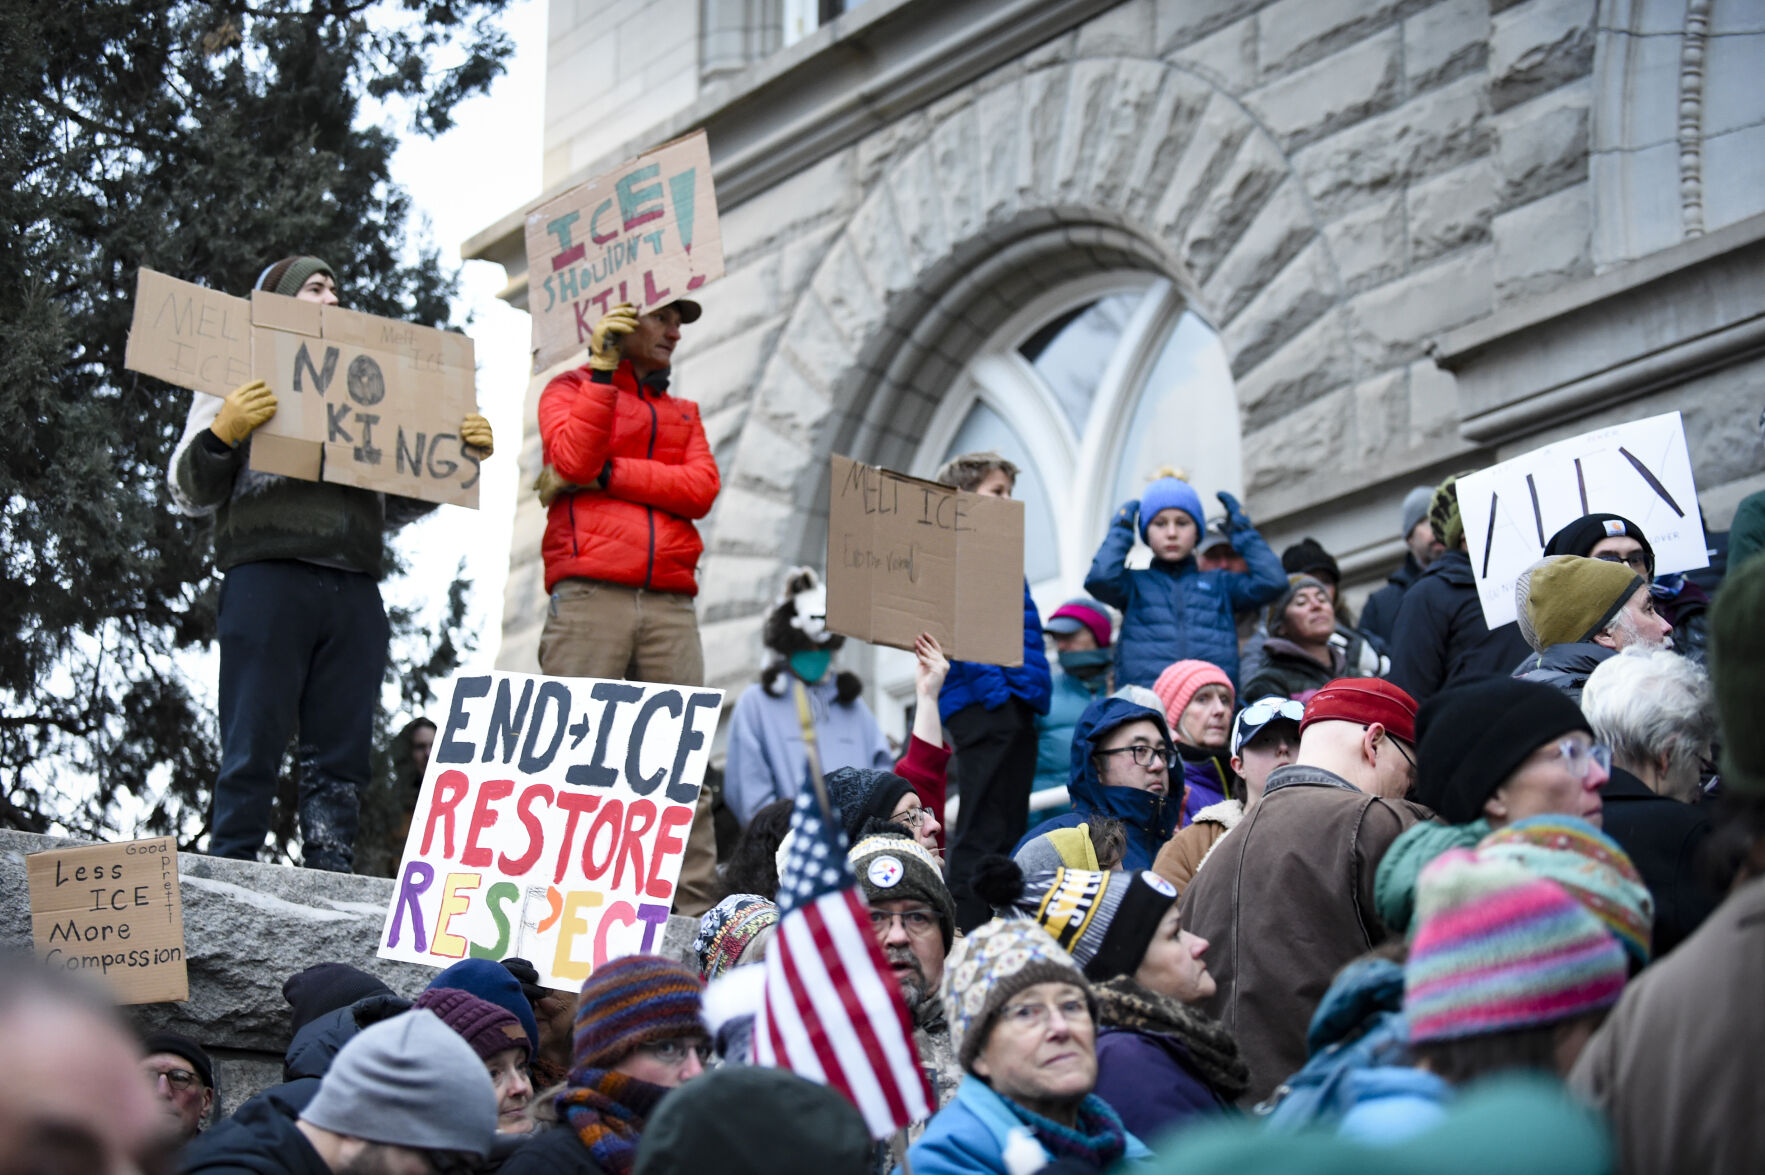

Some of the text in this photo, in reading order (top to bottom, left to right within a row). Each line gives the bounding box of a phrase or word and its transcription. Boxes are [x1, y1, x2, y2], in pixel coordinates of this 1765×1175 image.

[547, 163, 665, 273] ICE
[153, 291, 250, 343] MEL
[168, 337, 250, 388] ICE
[292, 341, 386, 406] NO
[326, 402, 481, 489] KINGS
[841, 461, 910, 516] MELT
[435, 675, 722, 804] END ICE
[126, 840, 167, 856] Good
[420, 769, 693, 898] RESTORE
[56, 860, 123, 887] Less
[89, 886, 150, 912] ICE
[49, 919, 131, 943] More
[387, 861, 670, 981] RESPECT
[45, 947, 181, 975] Compassion
